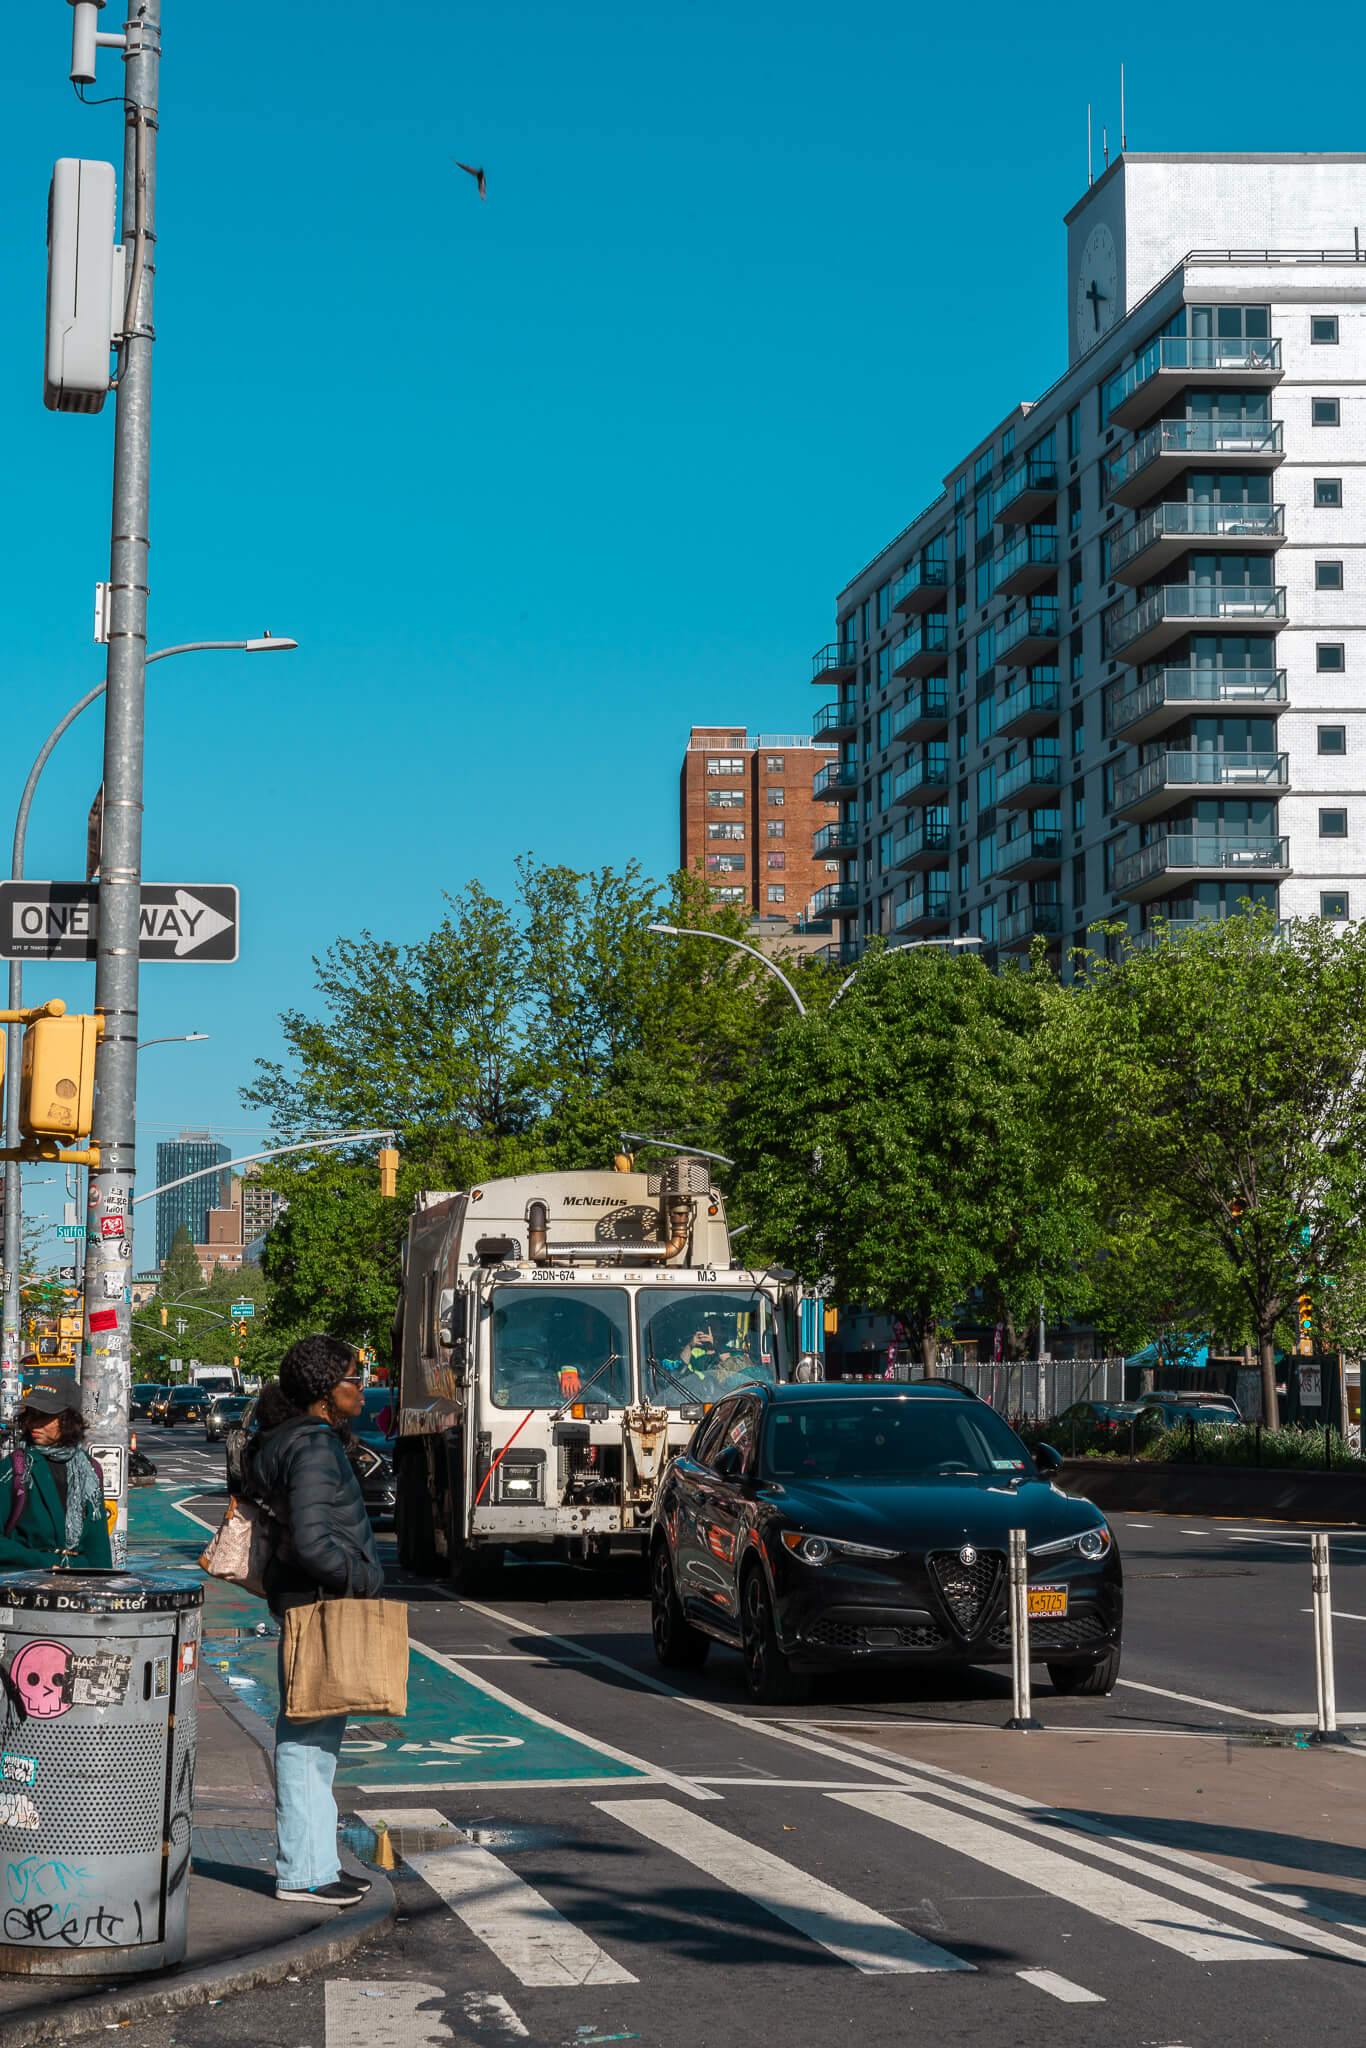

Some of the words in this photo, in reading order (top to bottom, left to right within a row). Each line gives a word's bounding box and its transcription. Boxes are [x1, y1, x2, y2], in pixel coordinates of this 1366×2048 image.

[21, 906, 89, 935] ONE
[138, 908, 205, 937] WAY
[563, 1196, 628, 1207] McNeilus
[58, 1226, 86, 1237] Suffol
[532, 1270, 575, 1281] 25DN-674
[697, 1271, 717, 1282] M.3
